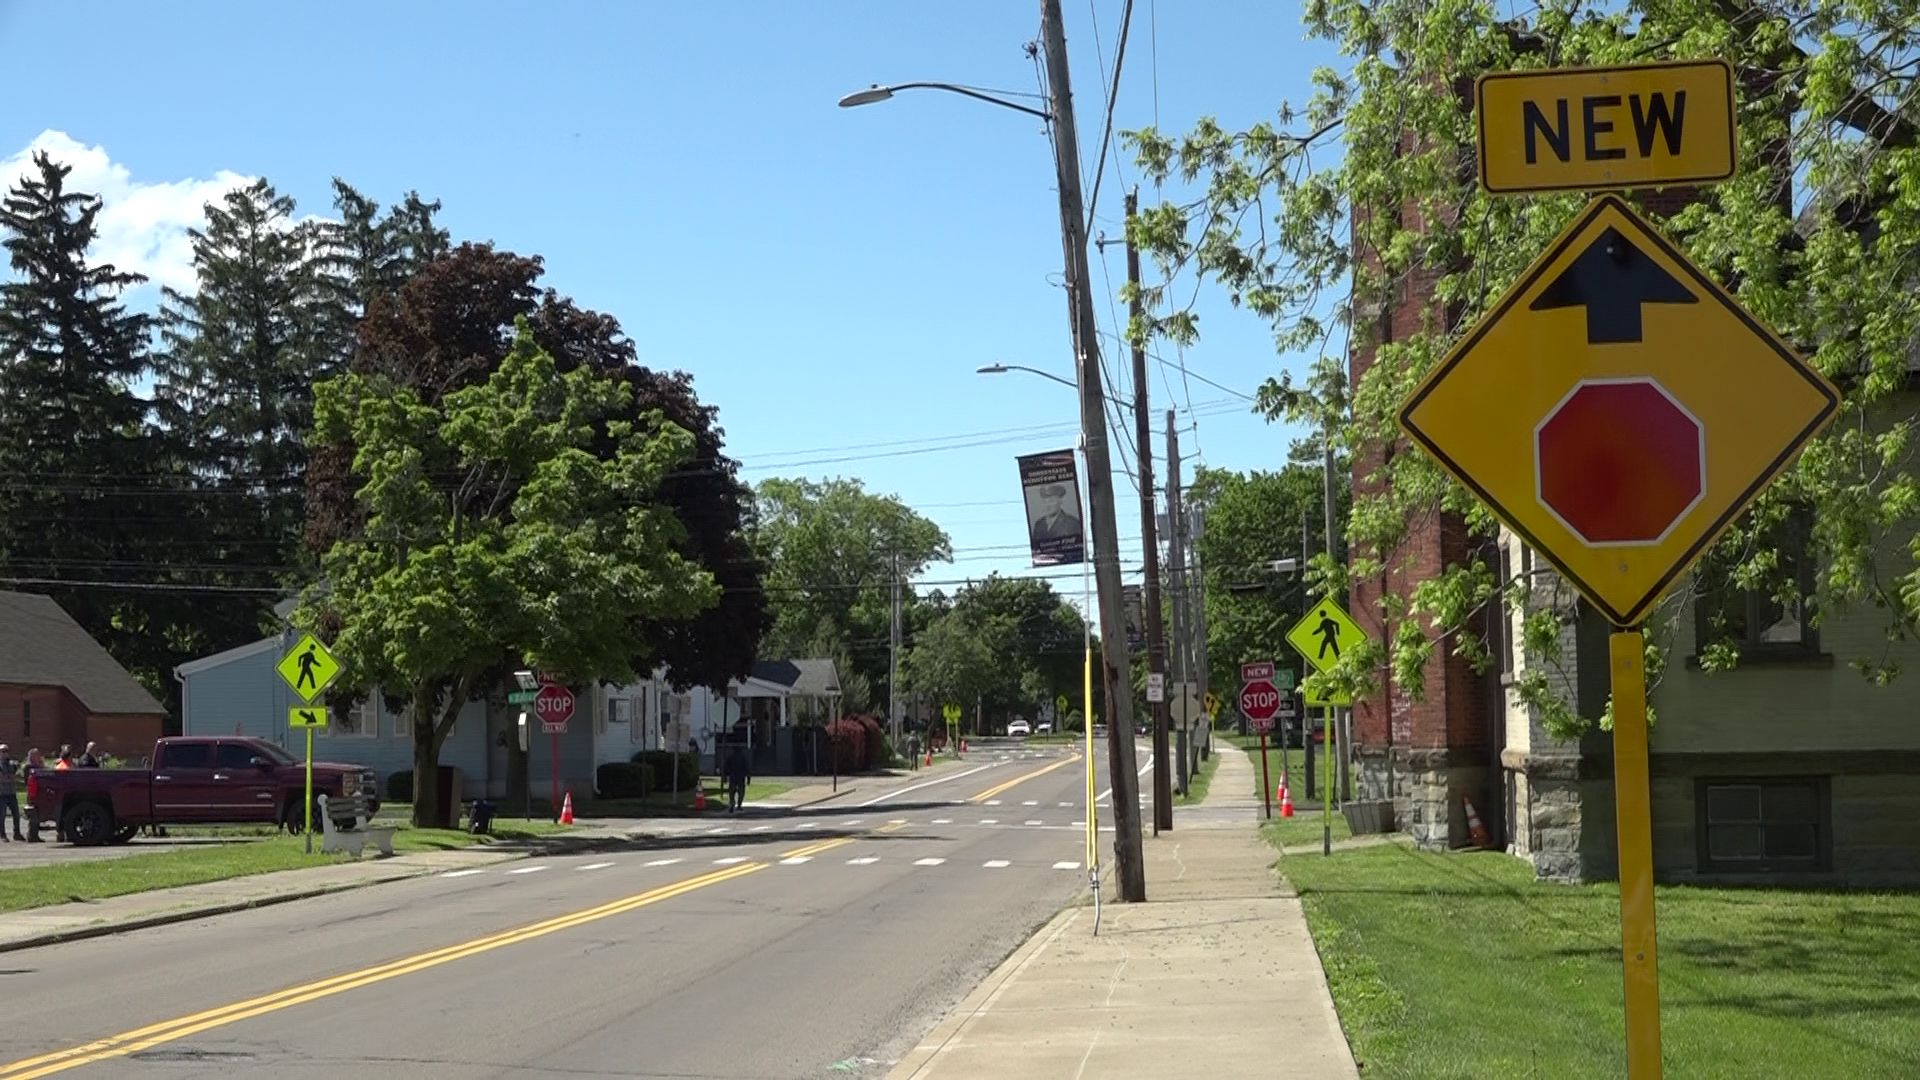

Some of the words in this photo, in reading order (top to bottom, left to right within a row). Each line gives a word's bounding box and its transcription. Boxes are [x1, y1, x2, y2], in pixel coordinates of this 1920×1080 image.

[1523, 90, 1686, 164] NEW
[1247, 668, 1269, 677] NEW
[537, 696, 571, 713] STOP
[1243, 692, 1277, 709] STOP
